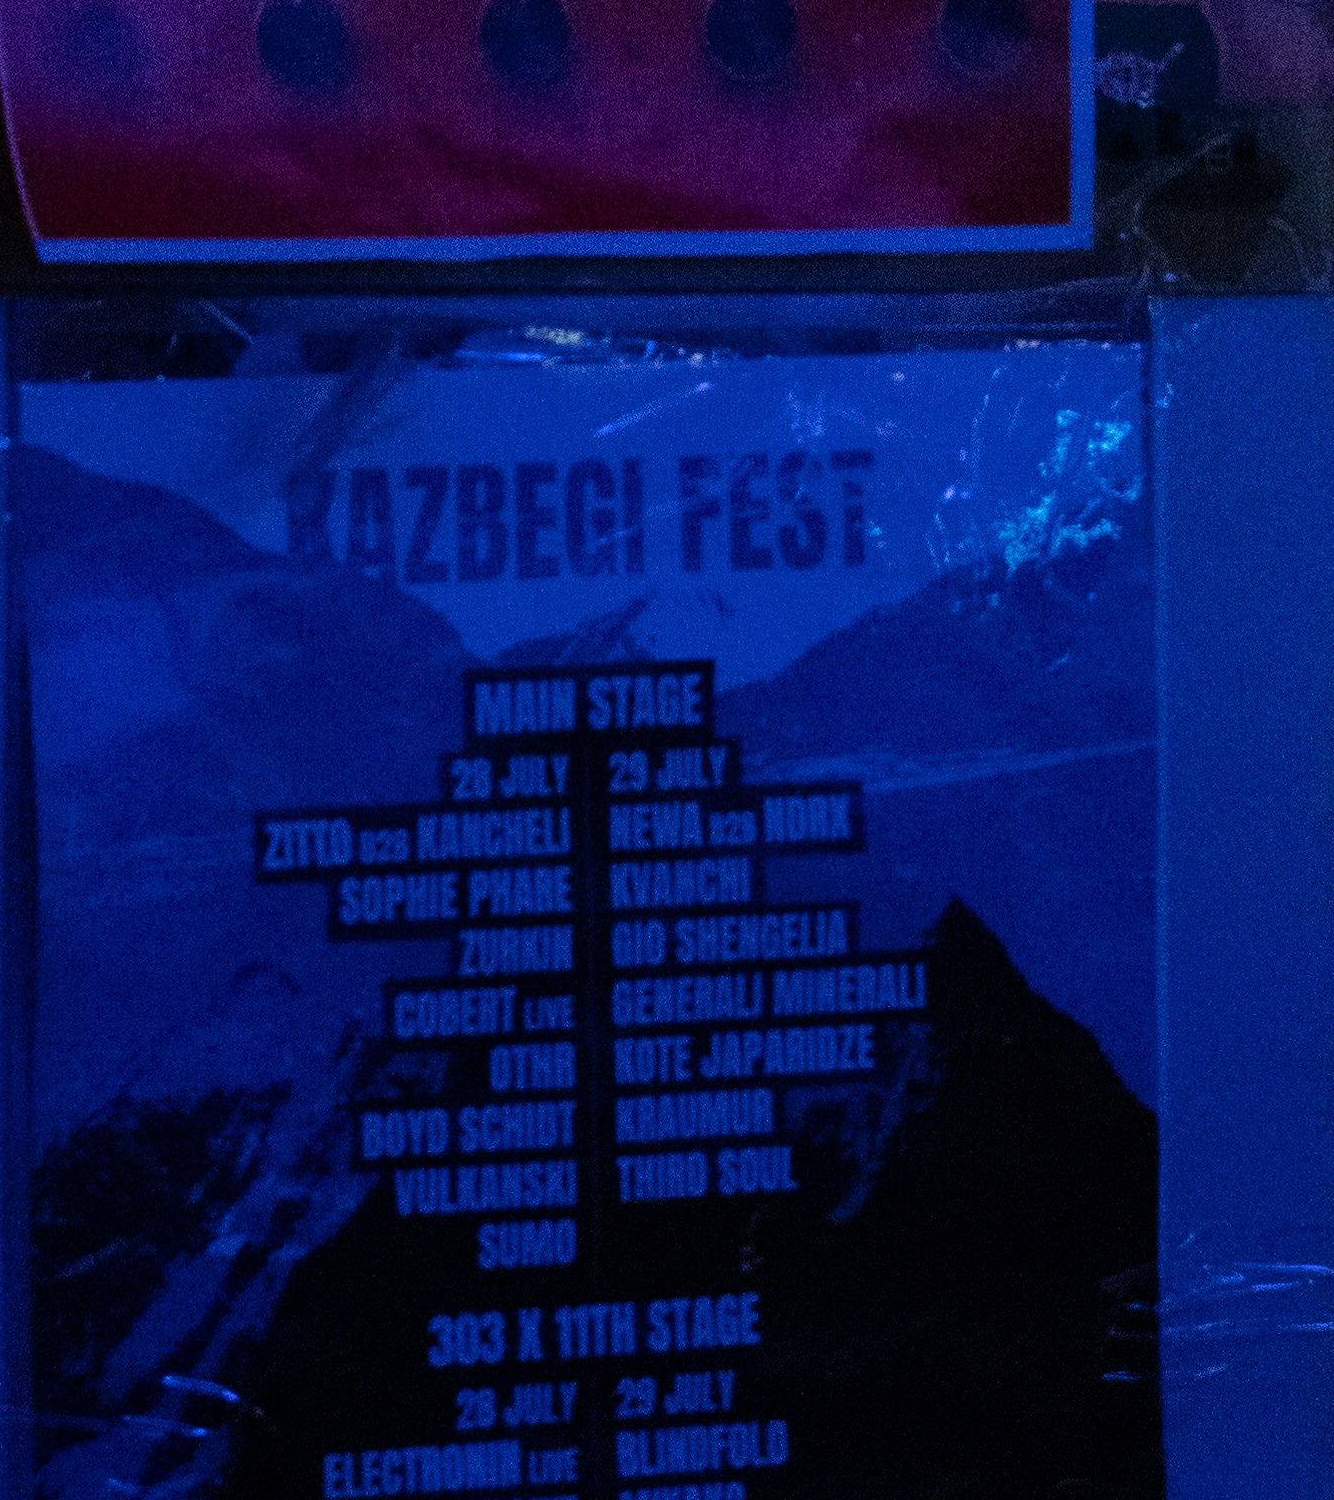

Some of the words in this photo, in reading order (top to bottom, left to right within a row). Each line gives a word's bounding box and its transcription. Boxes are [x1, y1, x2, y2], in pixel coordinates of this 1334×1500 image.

[284, 457, 645, 585] KAZBEGI
[678, 446, 876, 574] FEST
[473, 681, 579, 736] MAIN
[586, 673, 704, 729] STAGE
[450, 758, 494, 802] 28
[498, 754, 572, 798] JULY
[607, 750, 649, 792] 29
[653, 745, 730, 788] JULY
[261, 817, 354, 871] ZITTO
[416, 806, 573, 863] KANCHELI
[608, 802, 703, 852] NEWA
[339, 873, 459, 924] SOPHIE
[466, 866, 574, 917] PHARE
[608, 857, 753, 911] KVANCHI
[610, 917, 665, 969] GIO
[674, 908, 849, 964] SHENGELIA
[392, 986, 518, 1041] COBERT
[523, 994, 576, 1032] LIVE
[610, 970, 765, 1028] GENERALI
[772, 961, 929, 1018] MINERALI
[487, 1040, 578, 1094] OTHR
[613, 1033, 693, 1086] KOTE
[699, 1022, 877, 1080] JAPARIDZE
[359, 1108, 451, 1162] BOYD
[392, 1160, 579, 1219] VULKANSKI
[614, 1151, 710, 1204] THIRD
[717, 1144, 800, 1198] SOUL
[476, 1219, 579, 1273] SUMO
[426, 1310, 505, 1369] 303
[516, 1306, 544, 1361] X
[553, 1300, 637, 1358] 11TH
[644, 1291, 763, 1353] STAGE
[454, 1387, 498, 1432] 28
[501, 1380, 579, 1427] JULY
[613, 1377, 657, 1420] 29
[662, 1370, 737, 1417] JULY
[528, 1447, 580, 1485] LIVE
[614, 1418, 790, 1479] BLINDFOLD
